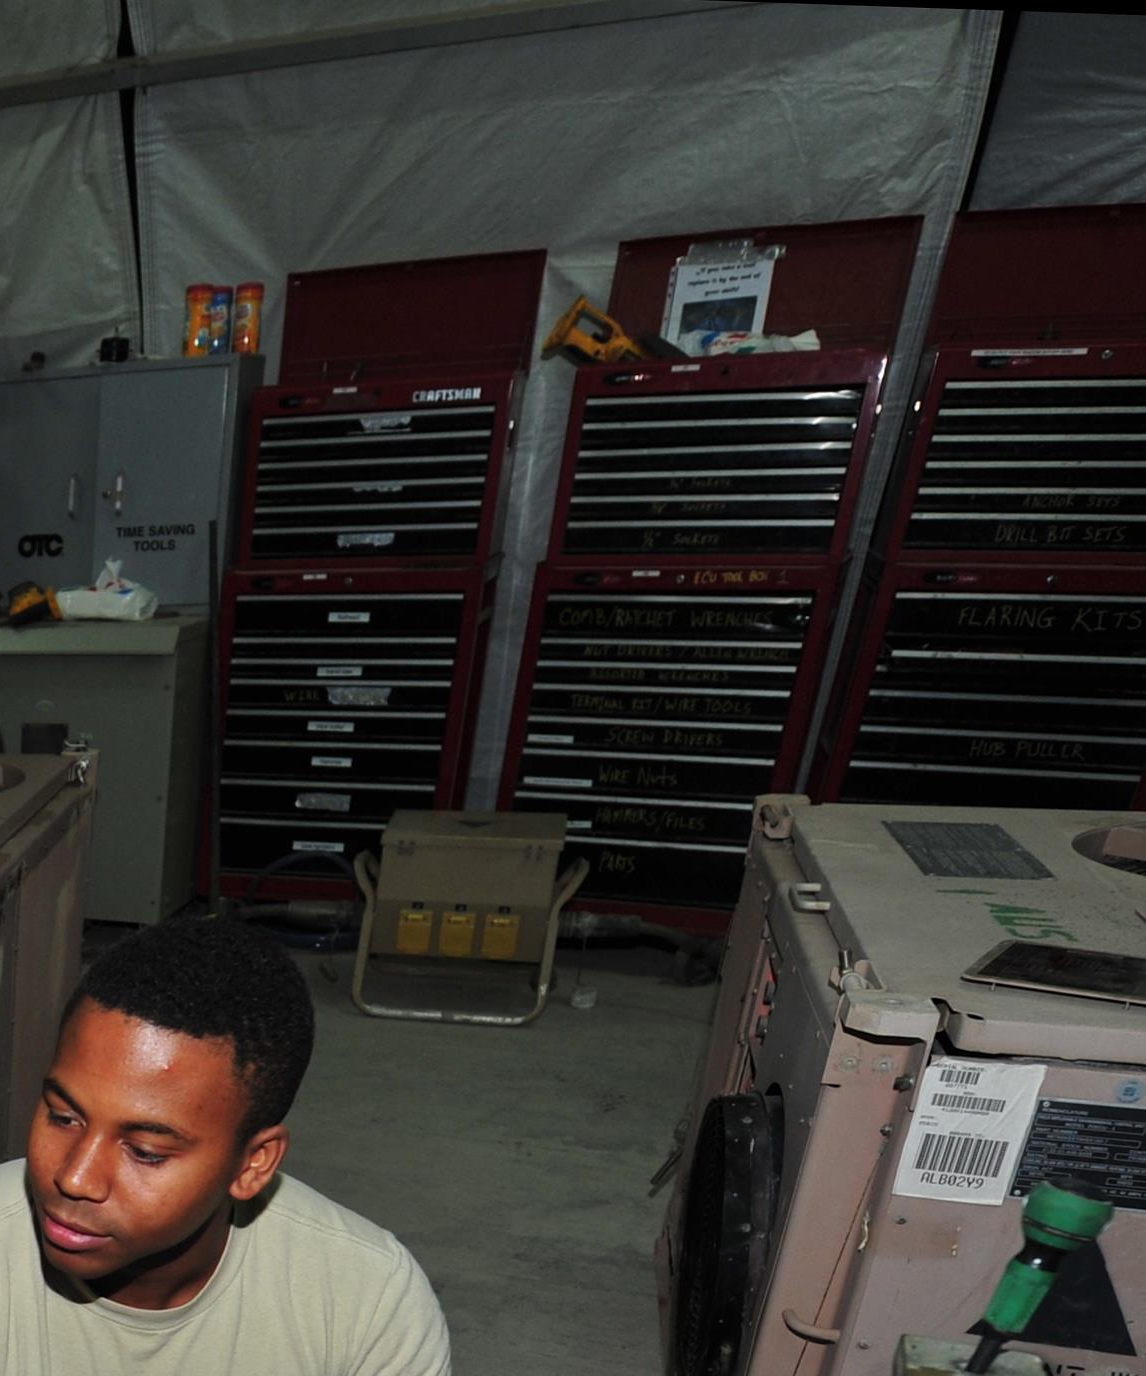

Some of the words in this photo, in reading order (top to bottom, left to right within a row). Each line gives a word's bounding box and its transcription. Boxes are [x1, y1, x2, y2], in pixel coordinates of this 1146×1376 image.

[412, 386, 482, 403] CRAFTSMAN
[116, 526, 145, 539] TIME
[148, 524, 196, 537] SAVING
[994, 523, 1038, 544] DRILL
[1081, 525, 1129, 544] SETS
[18, 533, 64, 558] OTC
[133, 539, 177, 552] TOOLS
[690, 607, 774, 627] WRENCHES
[957, 604, 1056, 629] FLARING
[1070, 607, 1144, 632] KITS
[705, 698, 752, 715] TOOLS
[606, 726, 654, 745] SCREW
[662, 728, 726, 747] DRIVERS
[968, 738, 1007, 759] HUB
[1013, 739, 1086, 761] PULLER
[920, 1171, 985, 1189] ALB02Y9
